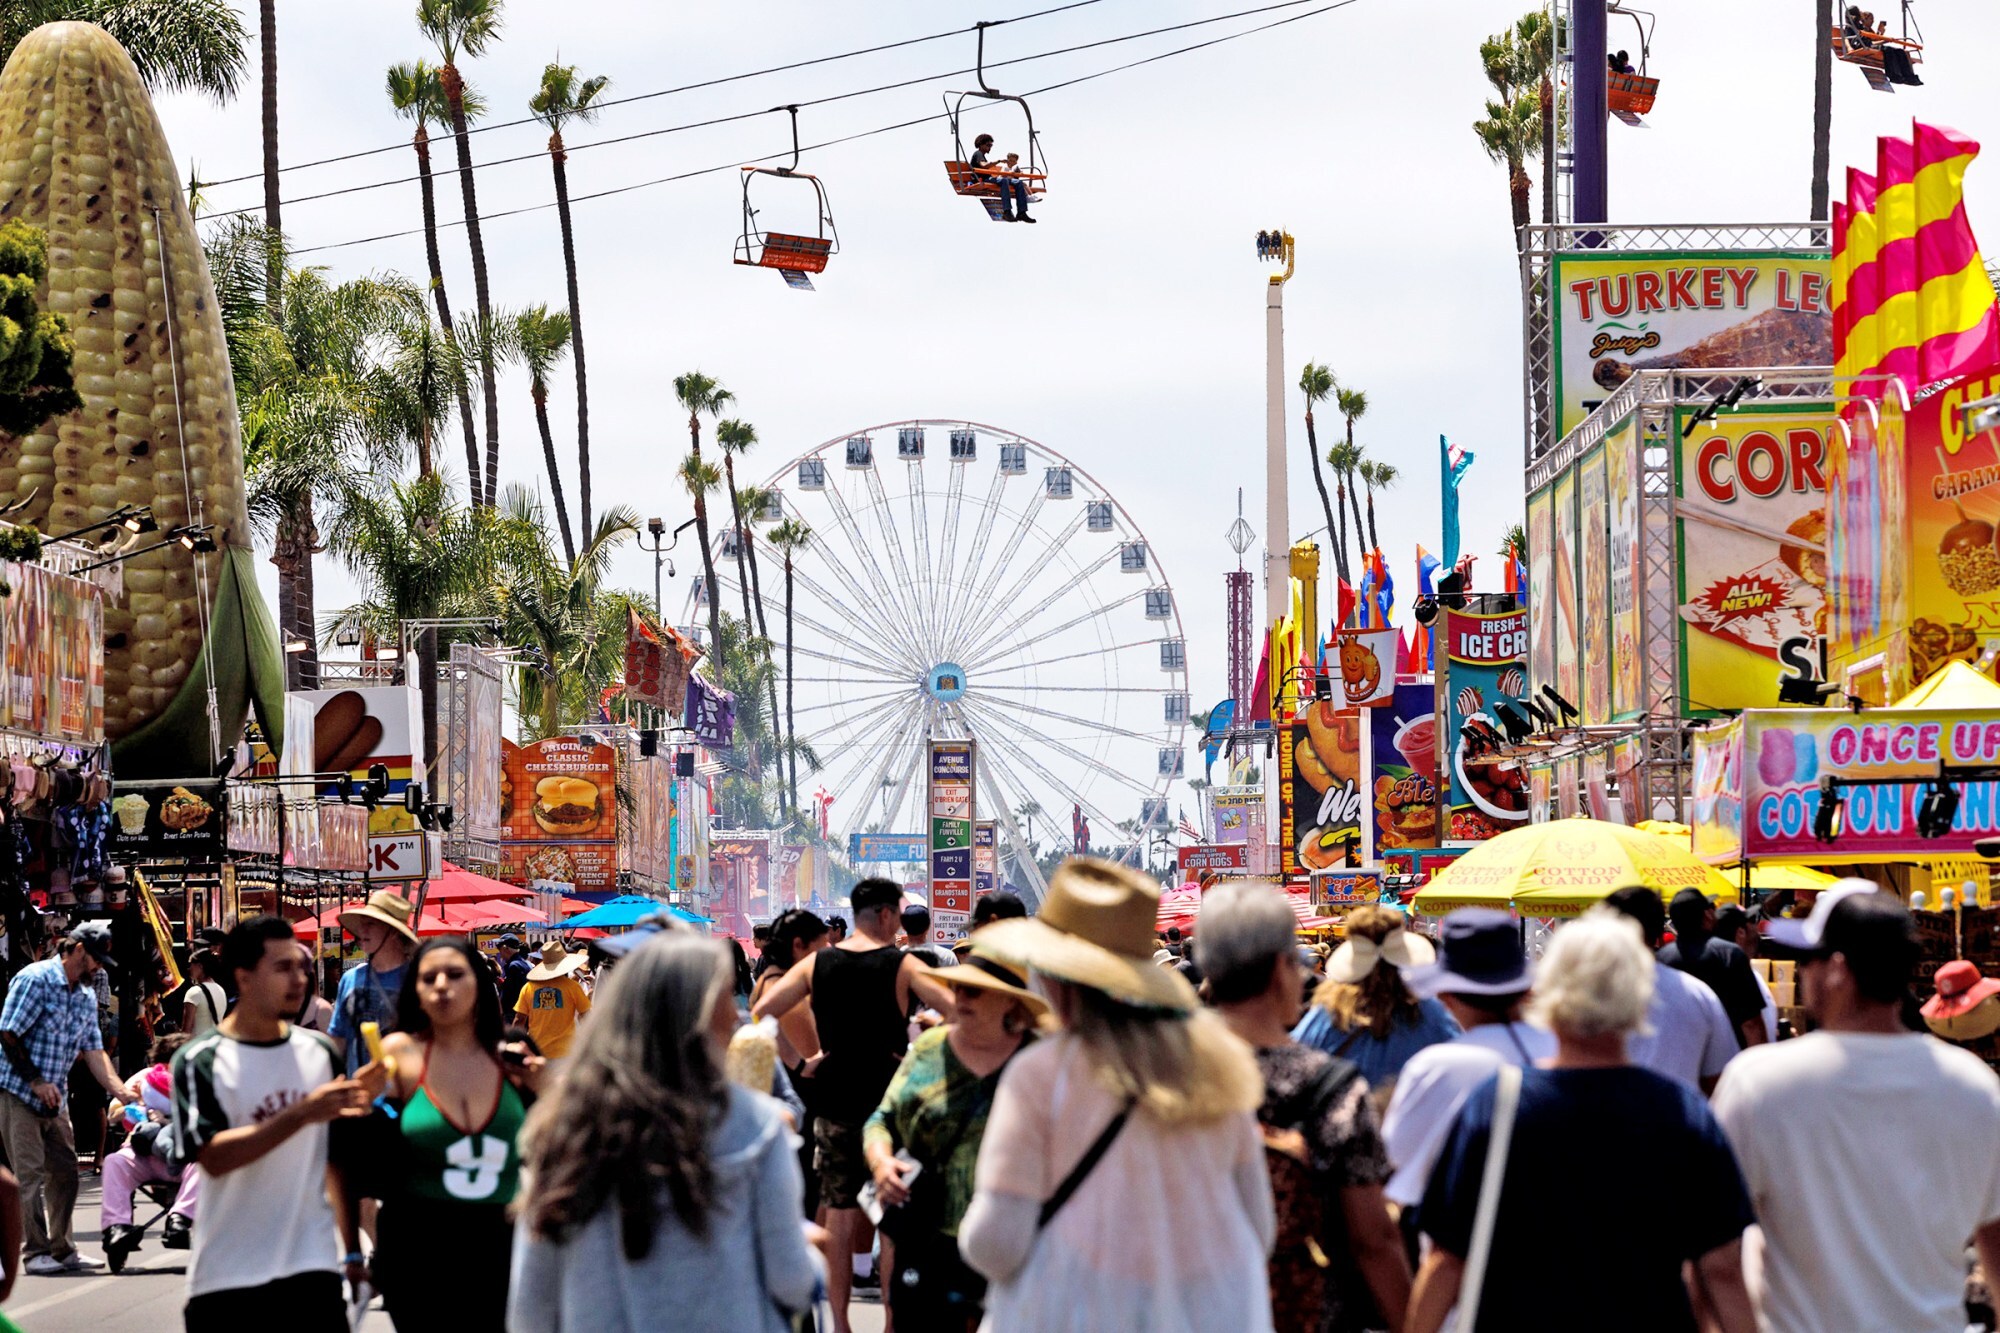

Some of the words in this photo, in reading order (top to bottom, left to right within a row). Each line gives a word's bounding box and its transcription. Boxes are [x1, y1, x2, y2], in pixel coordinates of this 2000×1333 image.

[1570, 267, 1757, 321] TURKEY
[1695, 427, 1832, 503] COR
[1726, 581, 1764, 599] ALL
[1720, 592, 1773, 612] NEW!
[1460, 632, 1494, 658] ICE
[540, 742, 595, 755] ORIGINAL
[1828, 722, 1942, 767] ONCE
[546, 754, 589, 763] CLASSIC
[1281, 730, 1293, 778] HOME
[938, 756, 964, 764] AVENUE
[524, 763, 610, 773] CHEESEBURGER
[933, 766, 969, 774] CONCOURSE
[1281, 782, 1294, 804] OF
[1387, 774, 1436, 808] Ble
[909, 844, 927, 860] FU
[1184, 858, 1207, 867] CORN
[1209, 857, 1232, 866] DOGS
[577, 865, 599, 873] CURD
[1449, 865, 1518, 876] COTTON
[1533, 865, 1622, 876] COTTON
[1642, 866, 1707, 876] COTTON
[1326, 876, 1356, 887] Dogs
[1447, 875, 1503, 886] CANDY
[1540, 875, 1616, 886] CANDY
[1656, 876, 1709, 885] CANDY
[1334, 884, 1344, 893] &
[1323, 893, 1366, 902] Nachos
[1523, 903, 1580, 913] COTTON
